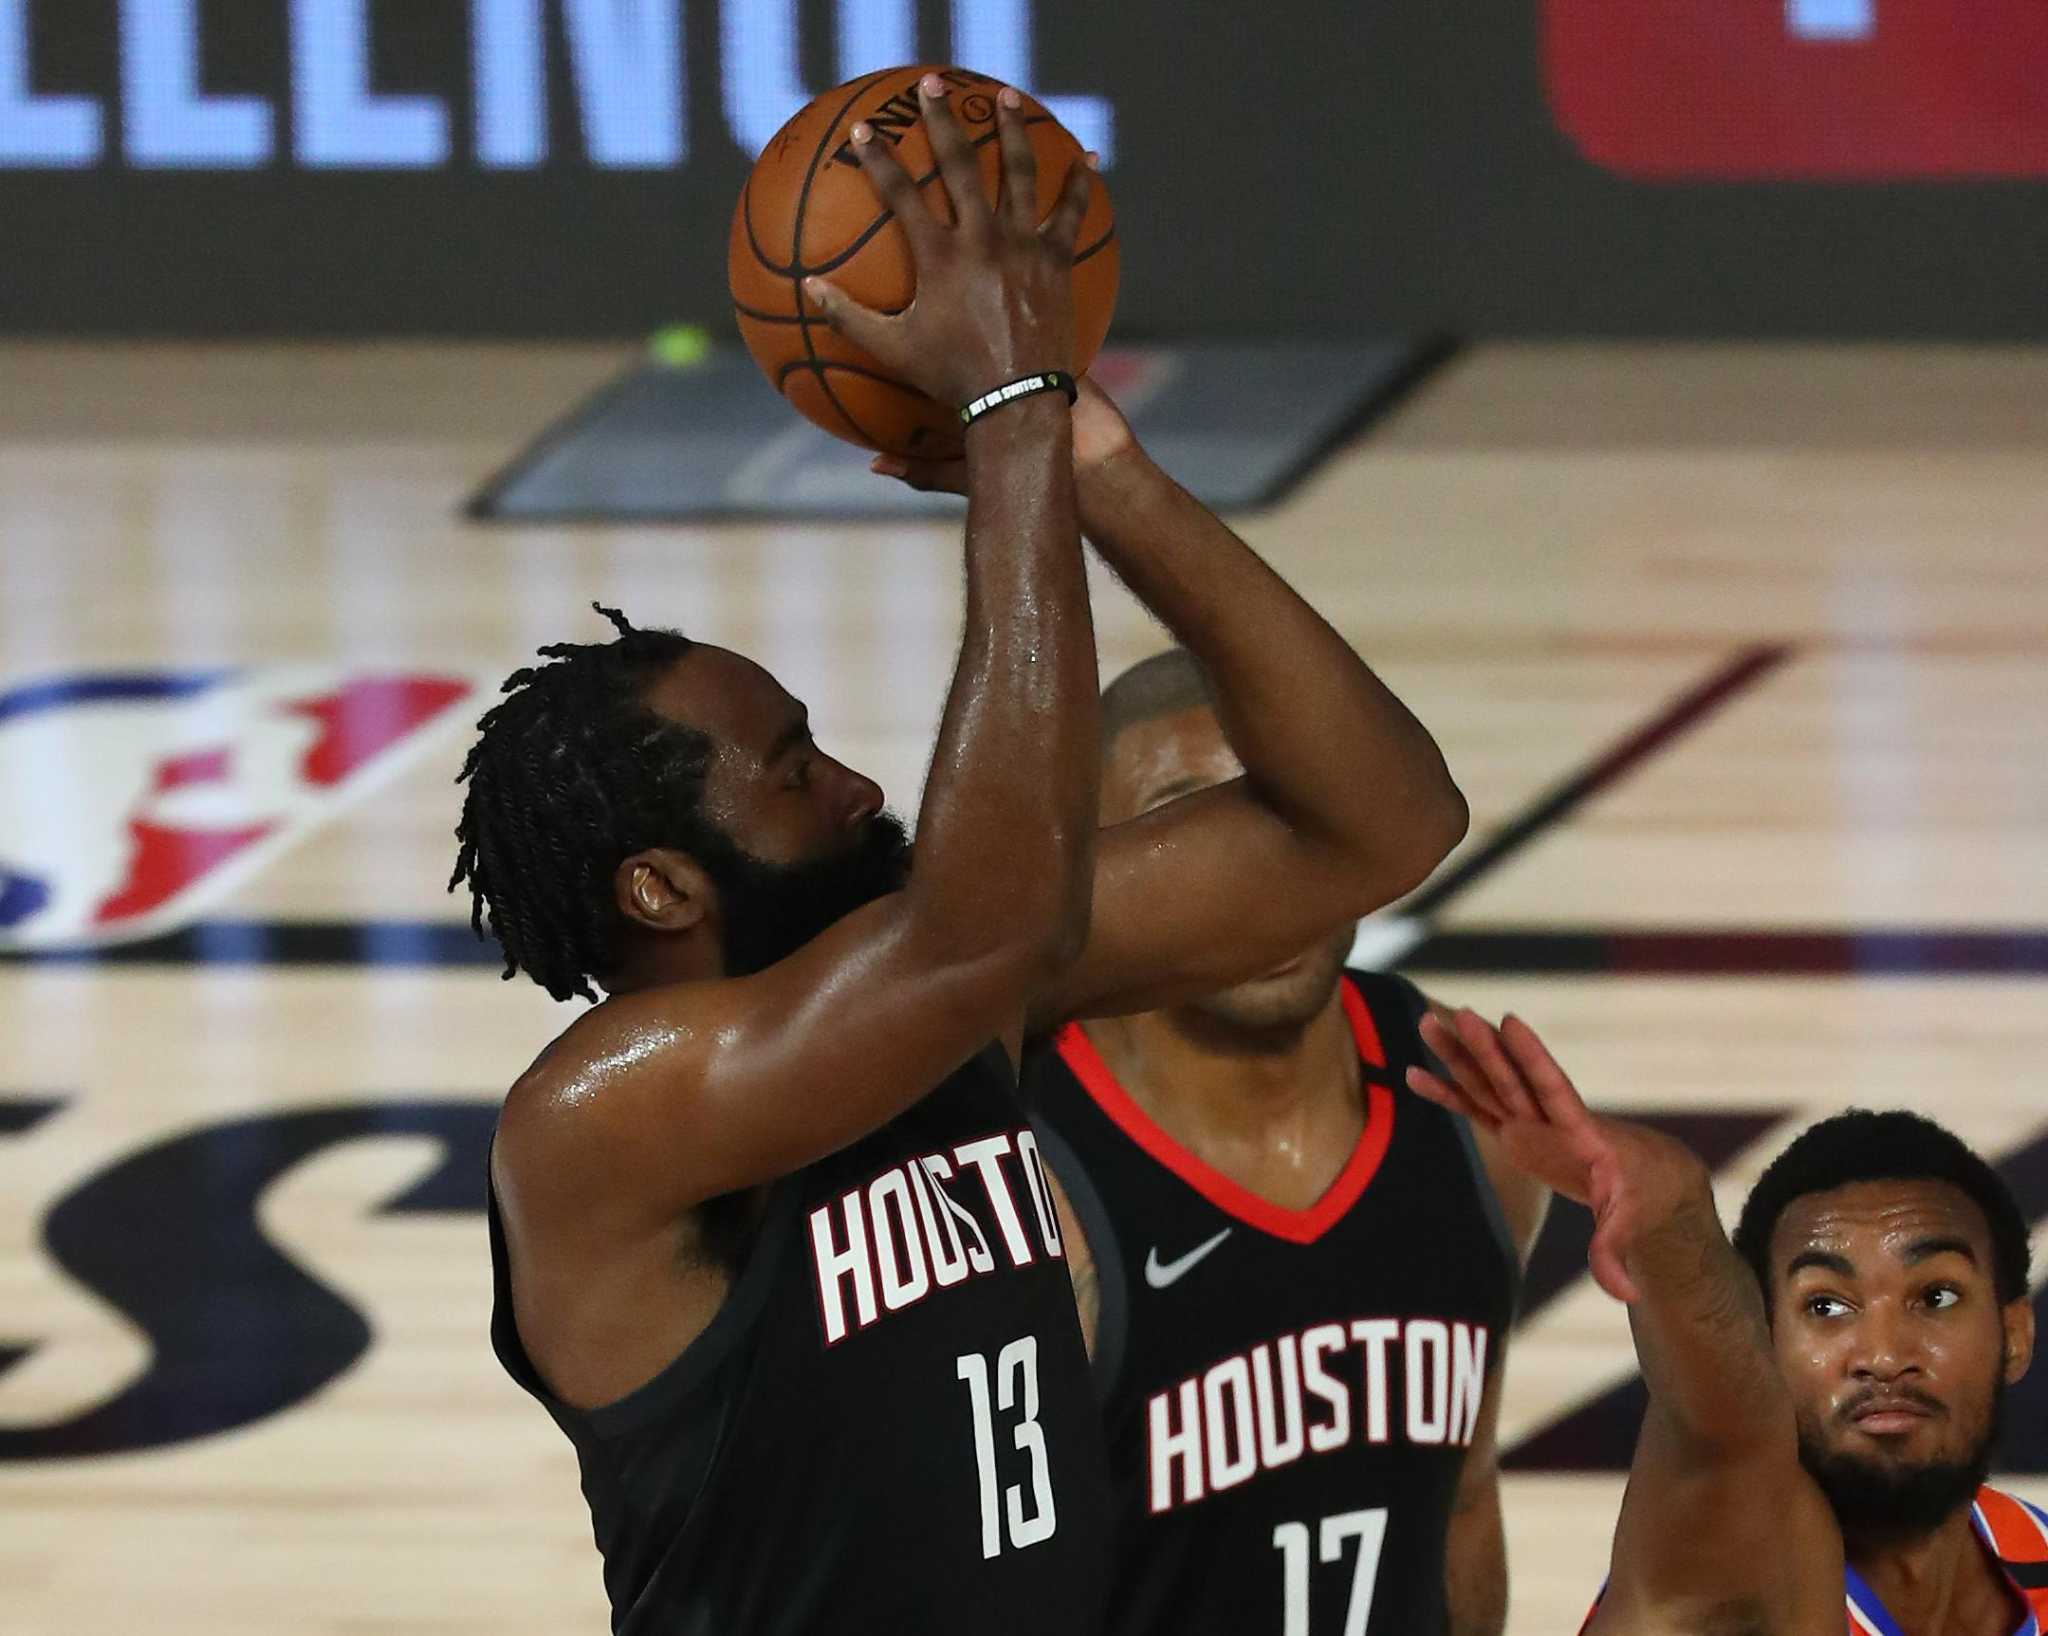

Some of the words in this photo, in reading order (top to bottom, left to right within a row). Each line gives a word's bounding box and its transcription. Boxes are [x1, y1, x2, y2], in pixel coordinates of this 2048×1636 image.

[807, 1128, 1063, 1346] HOUSTO
[956, 1335, 1057, 1560] 13
[1147, 1318, 1488, 1513] HOUSTON
[1272, 1507, 1389, 1636] 17
